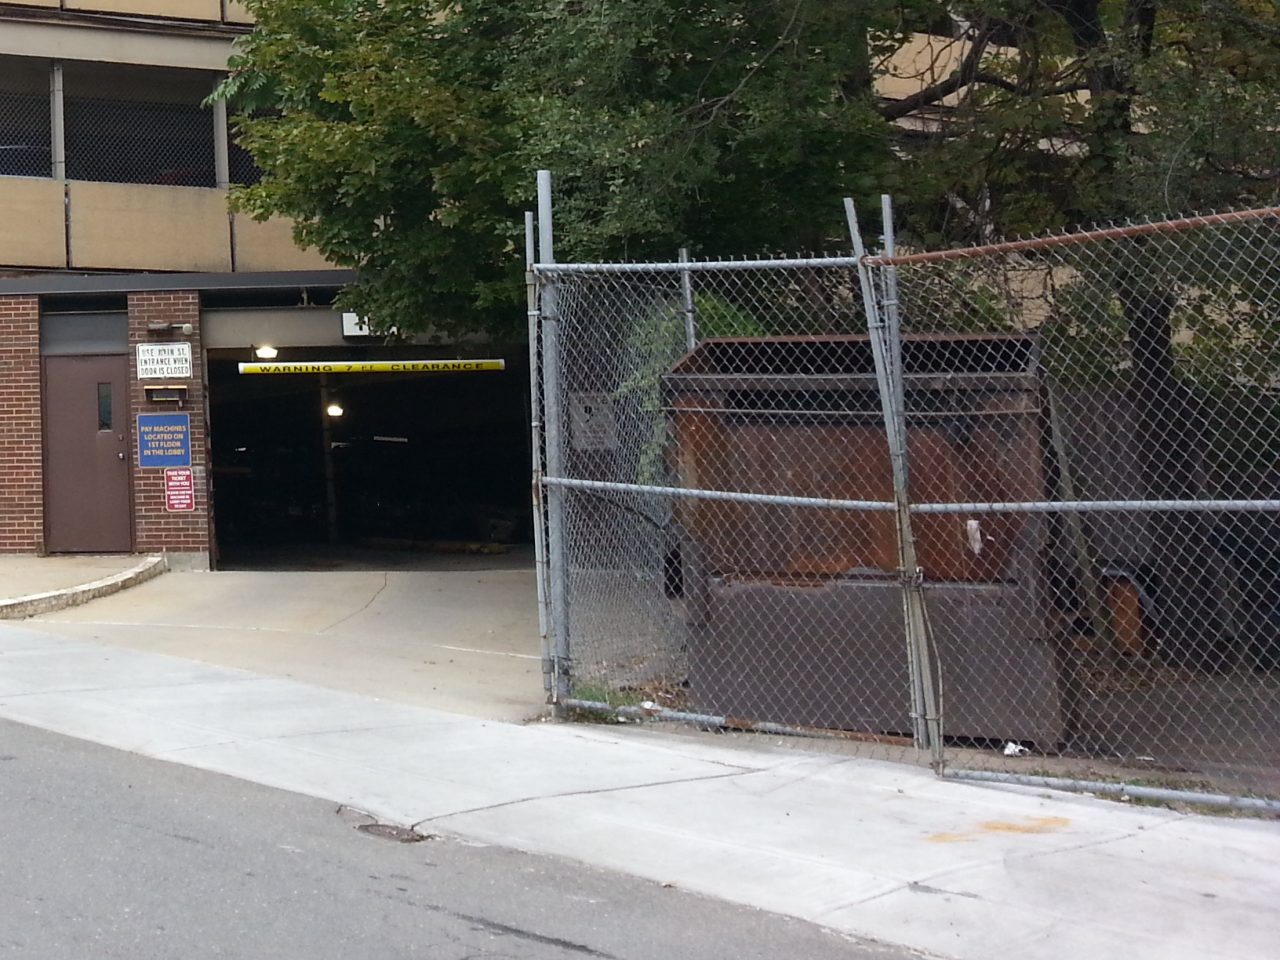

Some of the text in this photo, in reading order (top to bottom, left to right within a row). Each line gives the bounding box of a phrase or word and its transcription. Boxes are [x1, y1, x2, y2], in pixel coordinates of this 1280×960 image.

[141, 348, 155, 357] USE
[140, 357, 188, 366] ENTRANCE WHEN
[140, 366, 189, 376] DOOR IS CLOSED
[259, 364, 333, 373] WARNING
[391, 362, 483, 372] CLEARANCE
[164, 448, 185, 456] LOBBY
